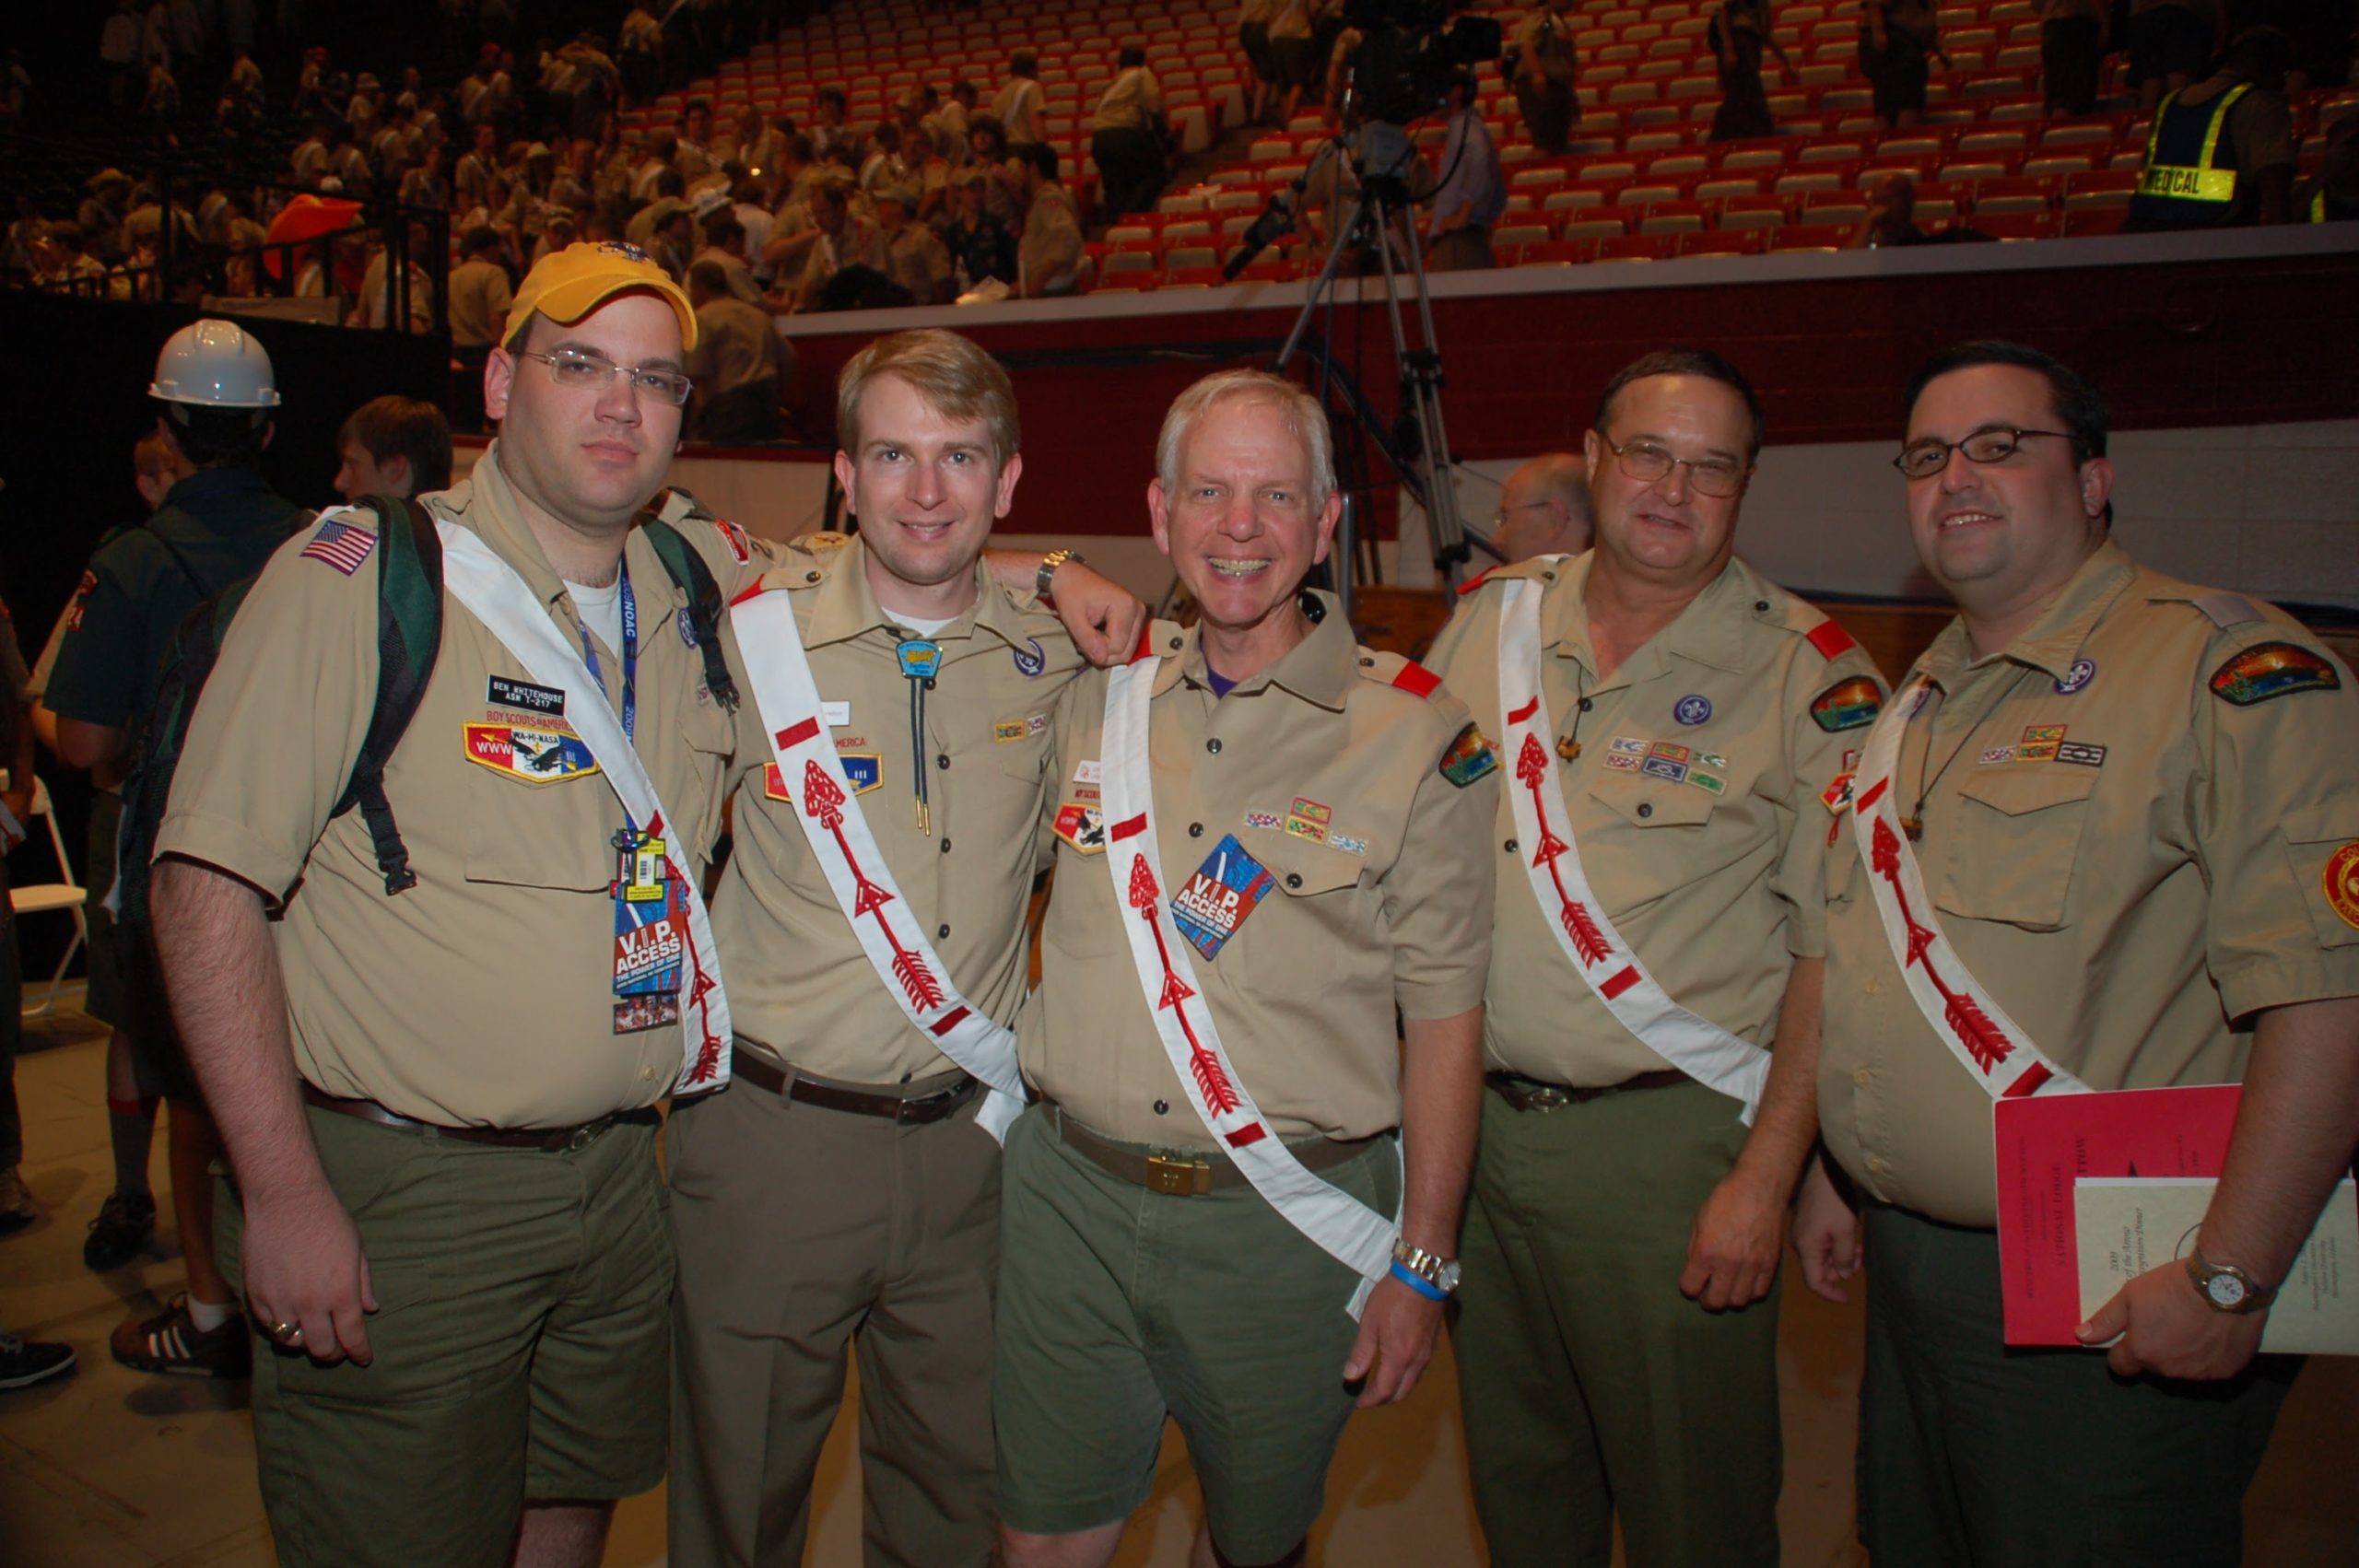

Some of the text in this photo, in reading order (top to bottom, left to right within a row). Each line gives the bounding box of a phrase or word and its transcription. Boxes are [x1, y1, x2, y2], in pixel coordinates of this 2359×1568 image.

[624, 601, 636, 638] NOAC
[493, 681, 563, 704] BEN WHITEHOUSE
[526, 696, 551, 708] T-217
[487, 710, 505, 722] BOY
[505, 713, 537, 727] SCOUTS
[543, 717, 573, 731] AMERIC
[476, 742, 512, 755] WWW
[834, 737, 866, 748] MERICA
[1178, 889, 1237, 930] ACCESS
[616, 937, 681, 975] ACCESS
